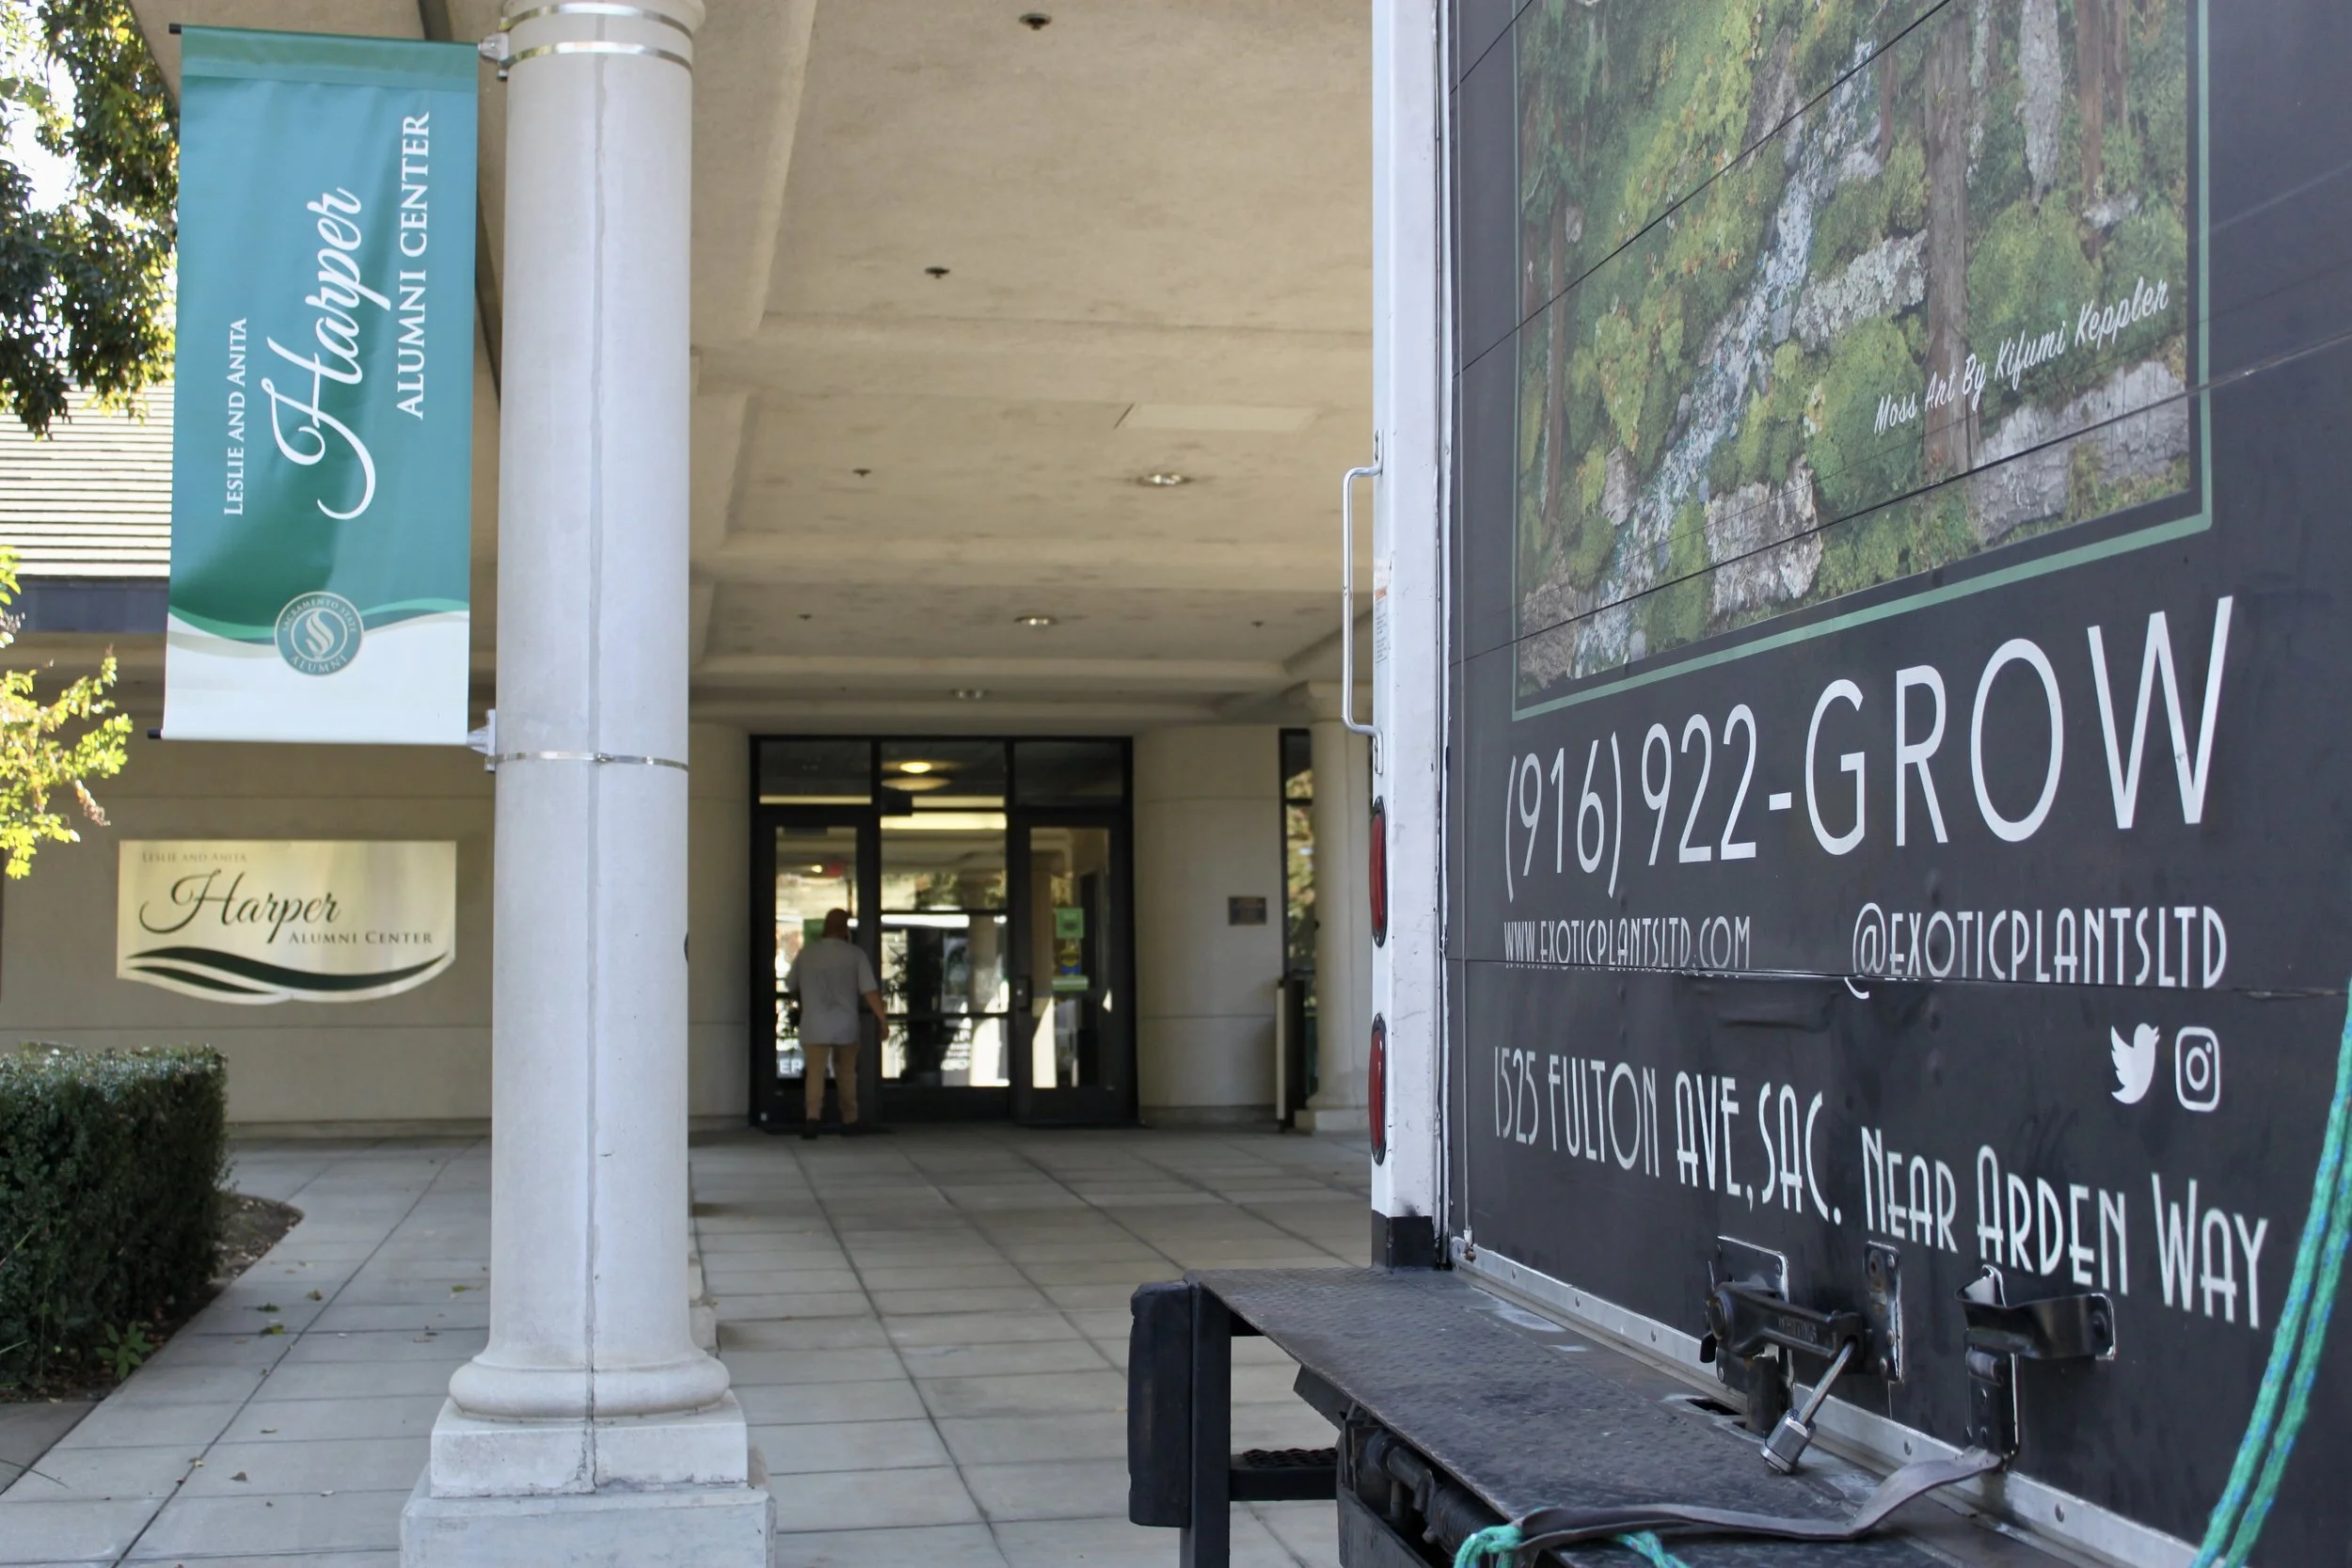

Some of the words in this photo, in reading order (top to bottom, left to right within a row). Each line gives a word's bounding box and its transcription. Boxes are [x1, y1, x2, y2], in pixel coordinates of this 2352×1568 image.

[399, 112, 430, 259] CENTER
[226, 317, 247, 388] ANITA
[261, 186, 391, 521] Harper
[396, 270, 426, 421] ALUMNI
[1874, 392, 1919, 435] Moss
[1924, 366, 1957, 414] Art
[1962, 353, 1988, 412] By
[1994, 321, 2067, 390] Kifumi
[2074, 276, 2169, 351] Keppler
[228, 390, 246, 443] AND
[224, 447, 245, 515] LESLIE
[282, 598, 339, 632] SACRAMENTO
[342, 607, 357, 632] STATE
[290, 655, 348, 673] ALUMNI
[1505, 730, 1623, 904] (916)
[1640, 595, 2233, 866] 922-GROW
[139, 867, 341, 944] Harper
[1503, 915, 1751, 977] WWW.EXOTICPLANTSLTD.COM
[1844, 902, 2228, 1000] @EXOTICPLANTSLTD
[1494, 1046, 1539, 1146] 1525
[1548, 1053, 1661, 1178] FULTON
